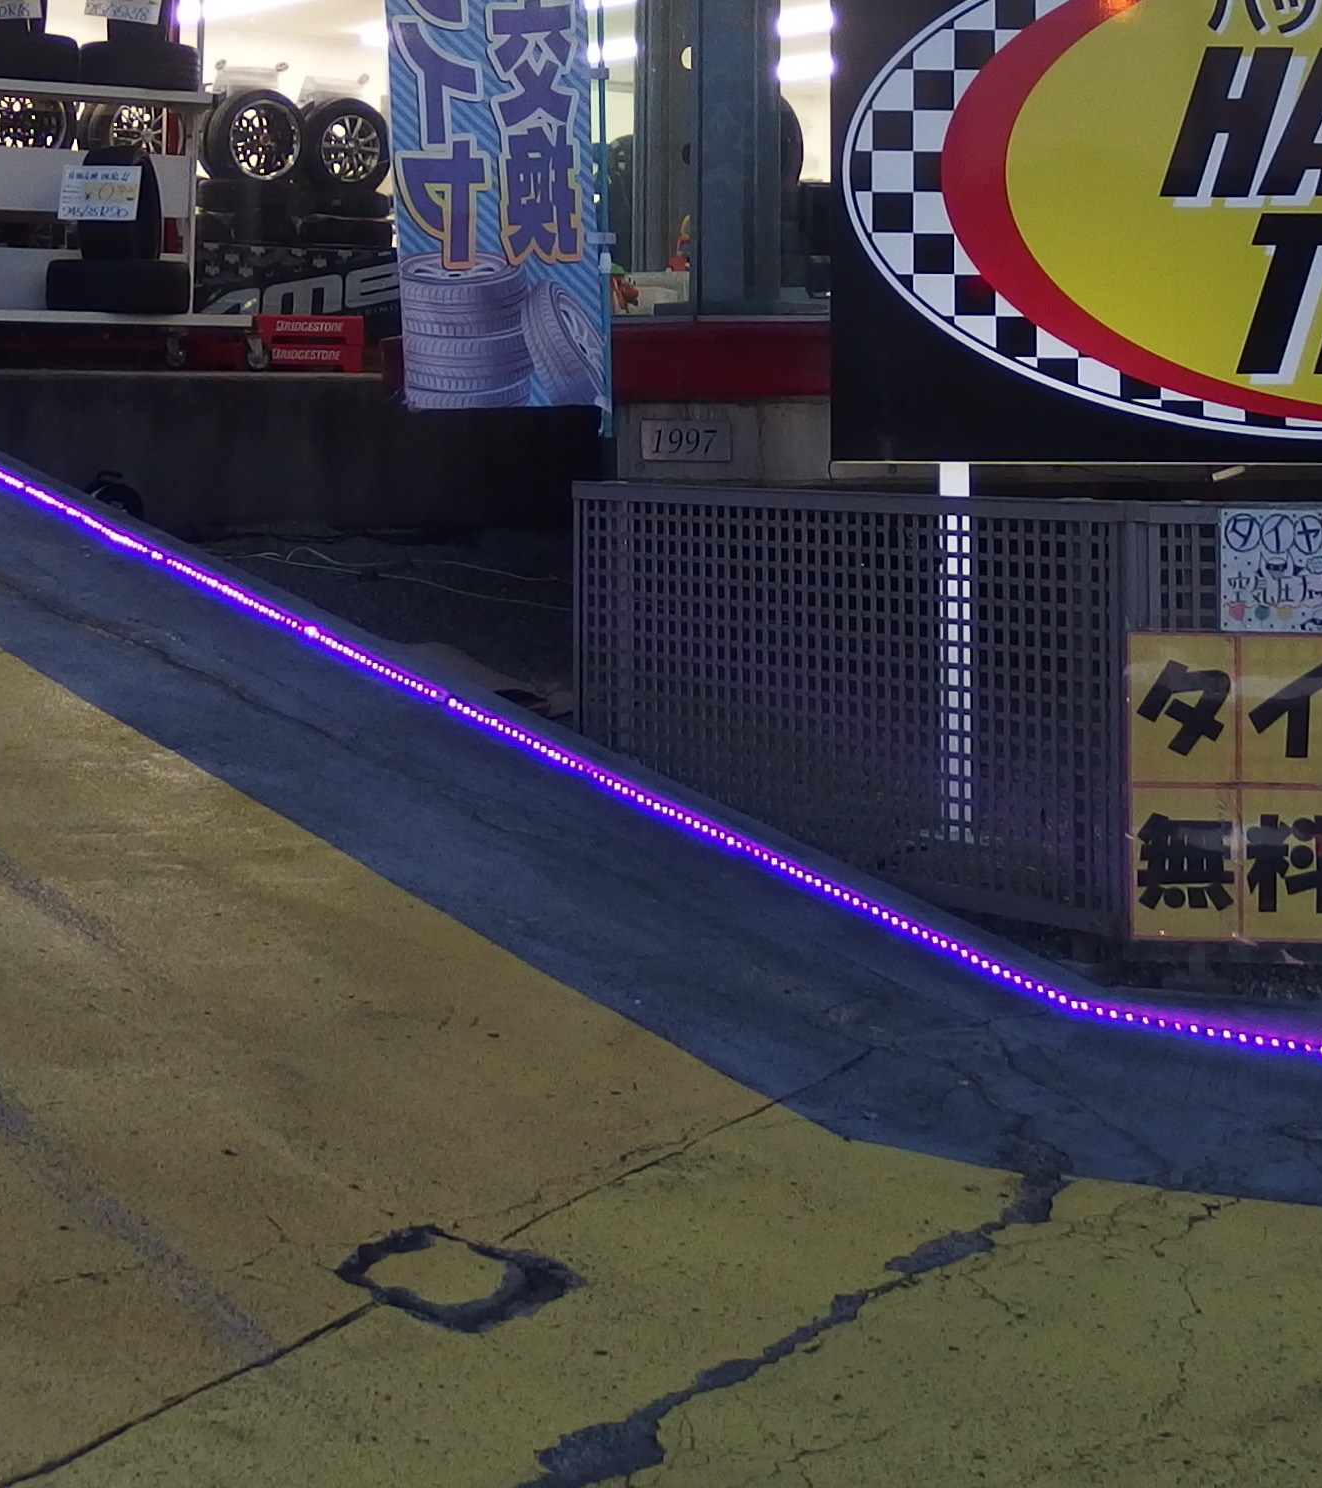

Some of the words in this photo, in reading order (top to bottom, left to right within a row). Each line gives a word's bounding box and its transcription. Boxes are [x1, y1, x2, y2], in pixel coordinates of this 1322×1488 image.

[275, 320, 345, 333] BRIDGESTONE
[272, 348, 342, 361] BRIDGESTONE
[651, 428, 717, 454] 1997
[1229, 515, 1321, 554] タイヤ
